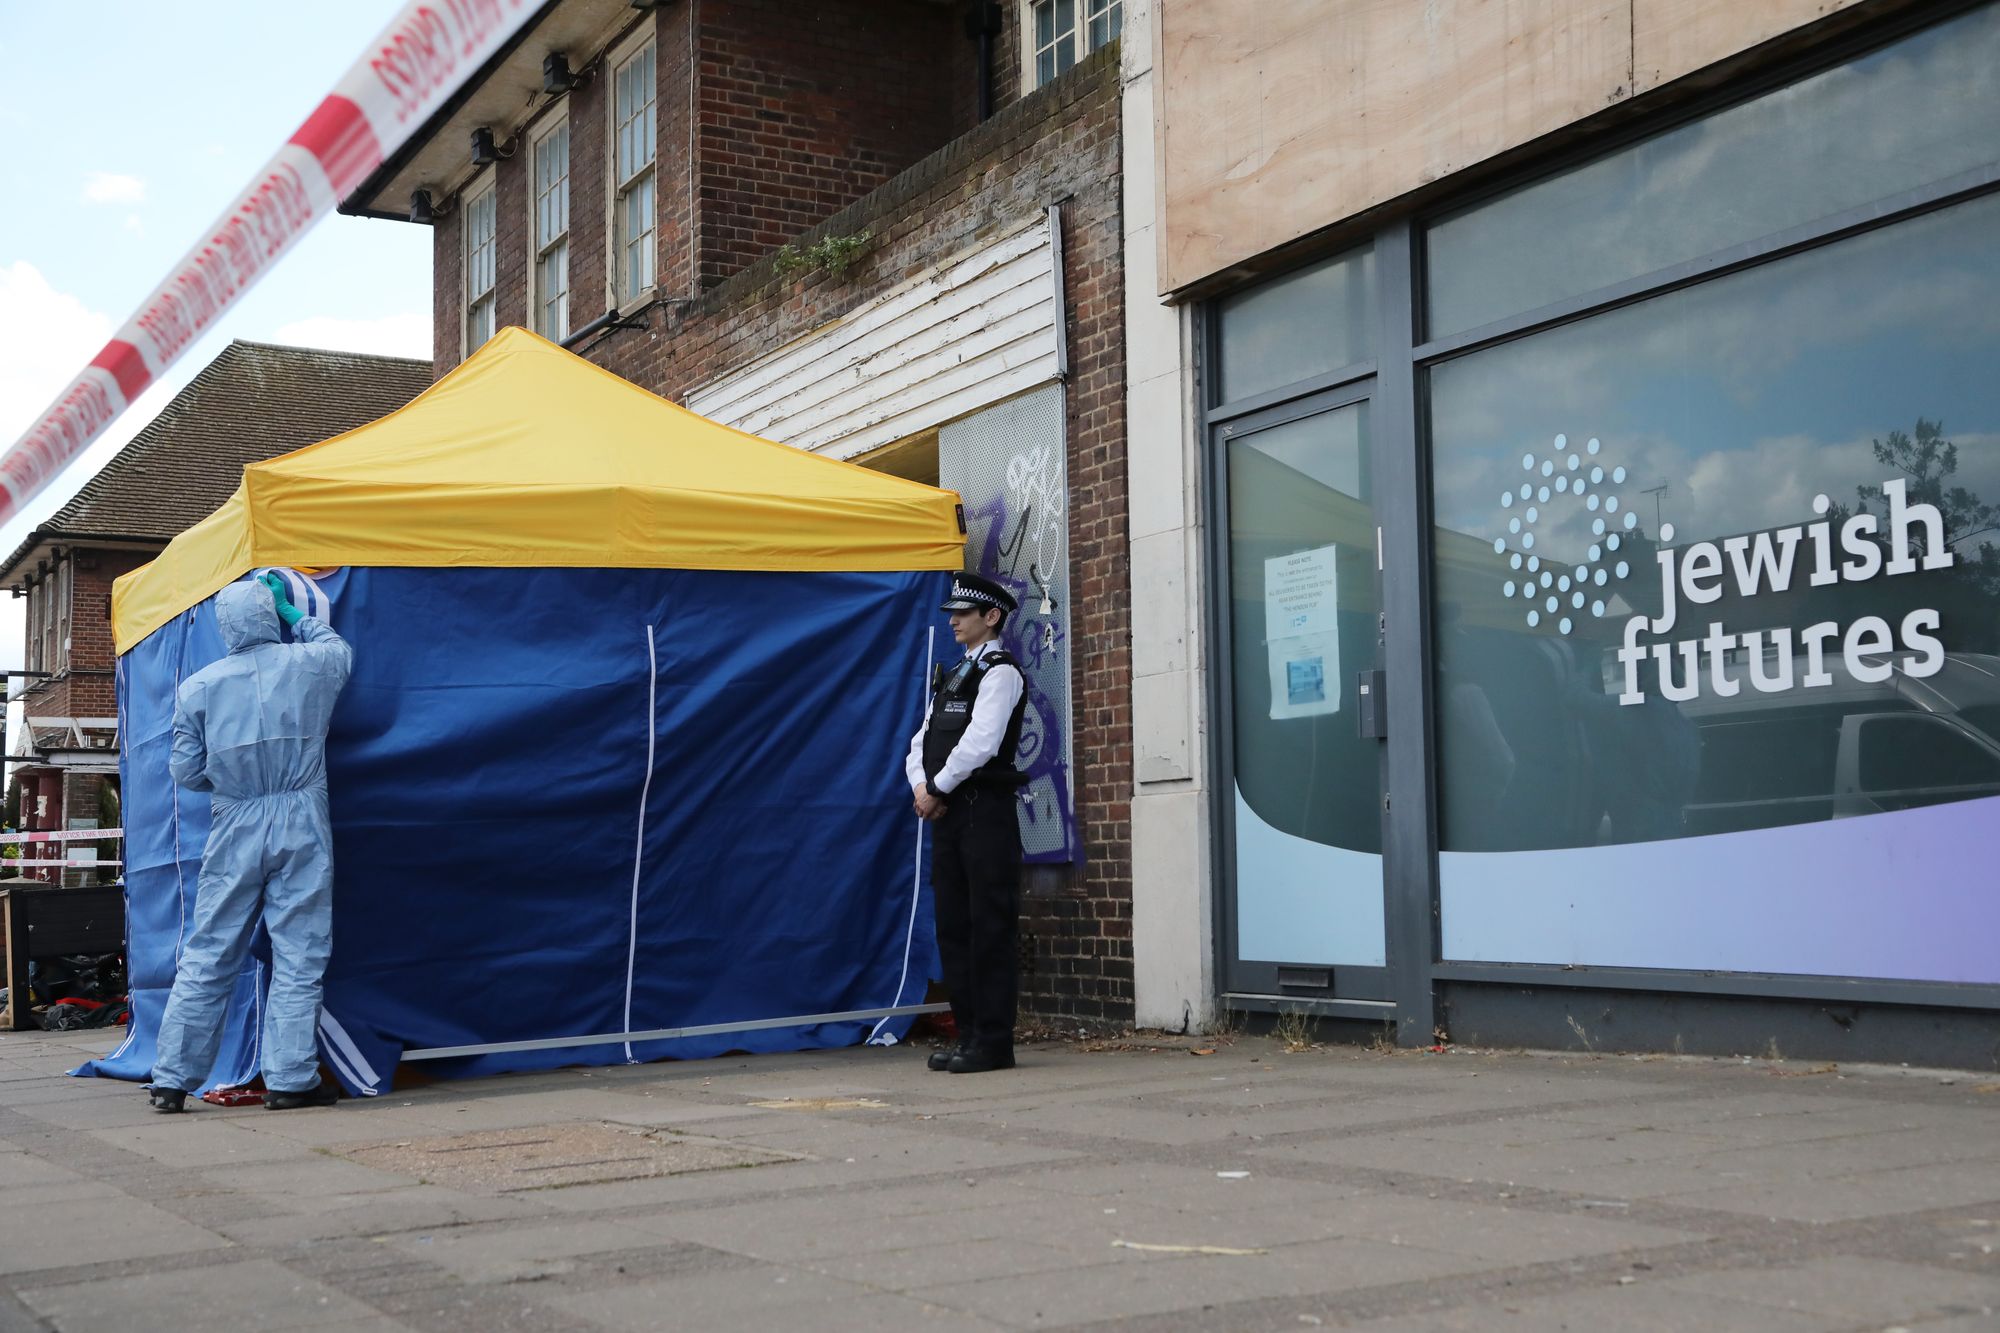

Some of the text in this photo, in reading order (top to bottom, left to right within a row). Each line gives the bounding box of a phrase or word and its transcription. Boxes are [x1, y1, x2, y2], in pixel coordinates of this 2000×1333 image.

[240, 161, 314, 257] POLICE
[137, 293, 192, 364] CROSS
[1652, 478, 1954, 634] jewish
[1618, 608, 1945, 706] futures
